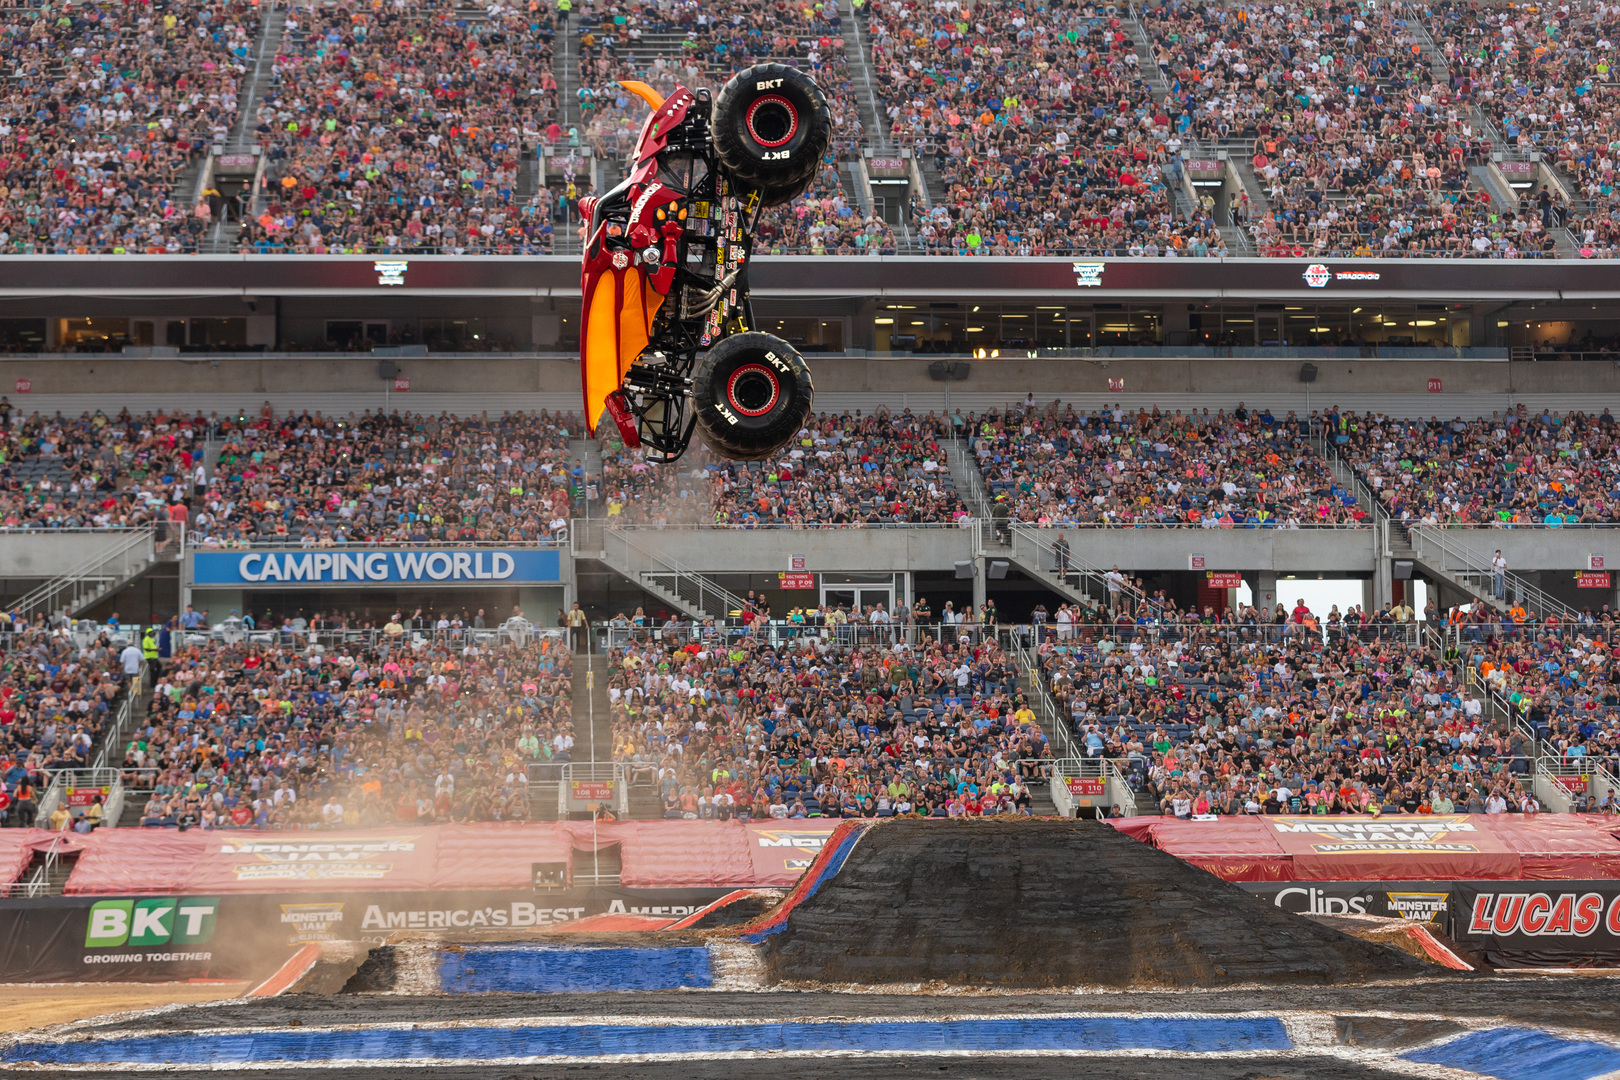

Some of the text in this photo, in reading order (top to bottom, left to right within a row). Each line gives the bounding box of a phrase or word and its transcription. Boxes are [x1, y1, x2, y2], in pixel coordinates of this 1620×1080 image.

[757, 79, 783, 90] BKT
[762, 150, 790, 160] BKT
[765, 351, 790, 373] BKT
[715, 403, 739, 425] BKT
[239, 552, 515, 582] CAMPING WORLD
[1273, 823, 1479, 833] MONSTER
[1341, 832, 1431, 841] JAM
[220, 843, 415, 854] MONSTER
[1318, 843, 1473, 851] WORLD FINALS
[281, 852, 360, 861] JAM
[1388, 901, 1448, 911] MONSTER
[281, 912, 343, 923] MONSTER
[360, 904, 508, 929] AMERICA'S
[1404, 910, 1431, 921] JAM
[1467, 892, 1605, 937] LUCAS
[90, 906, 215, 938] BKT
[298, 923, 327, 931] JAM
[83, 952, 212, 964] GROWING TOGETHER
